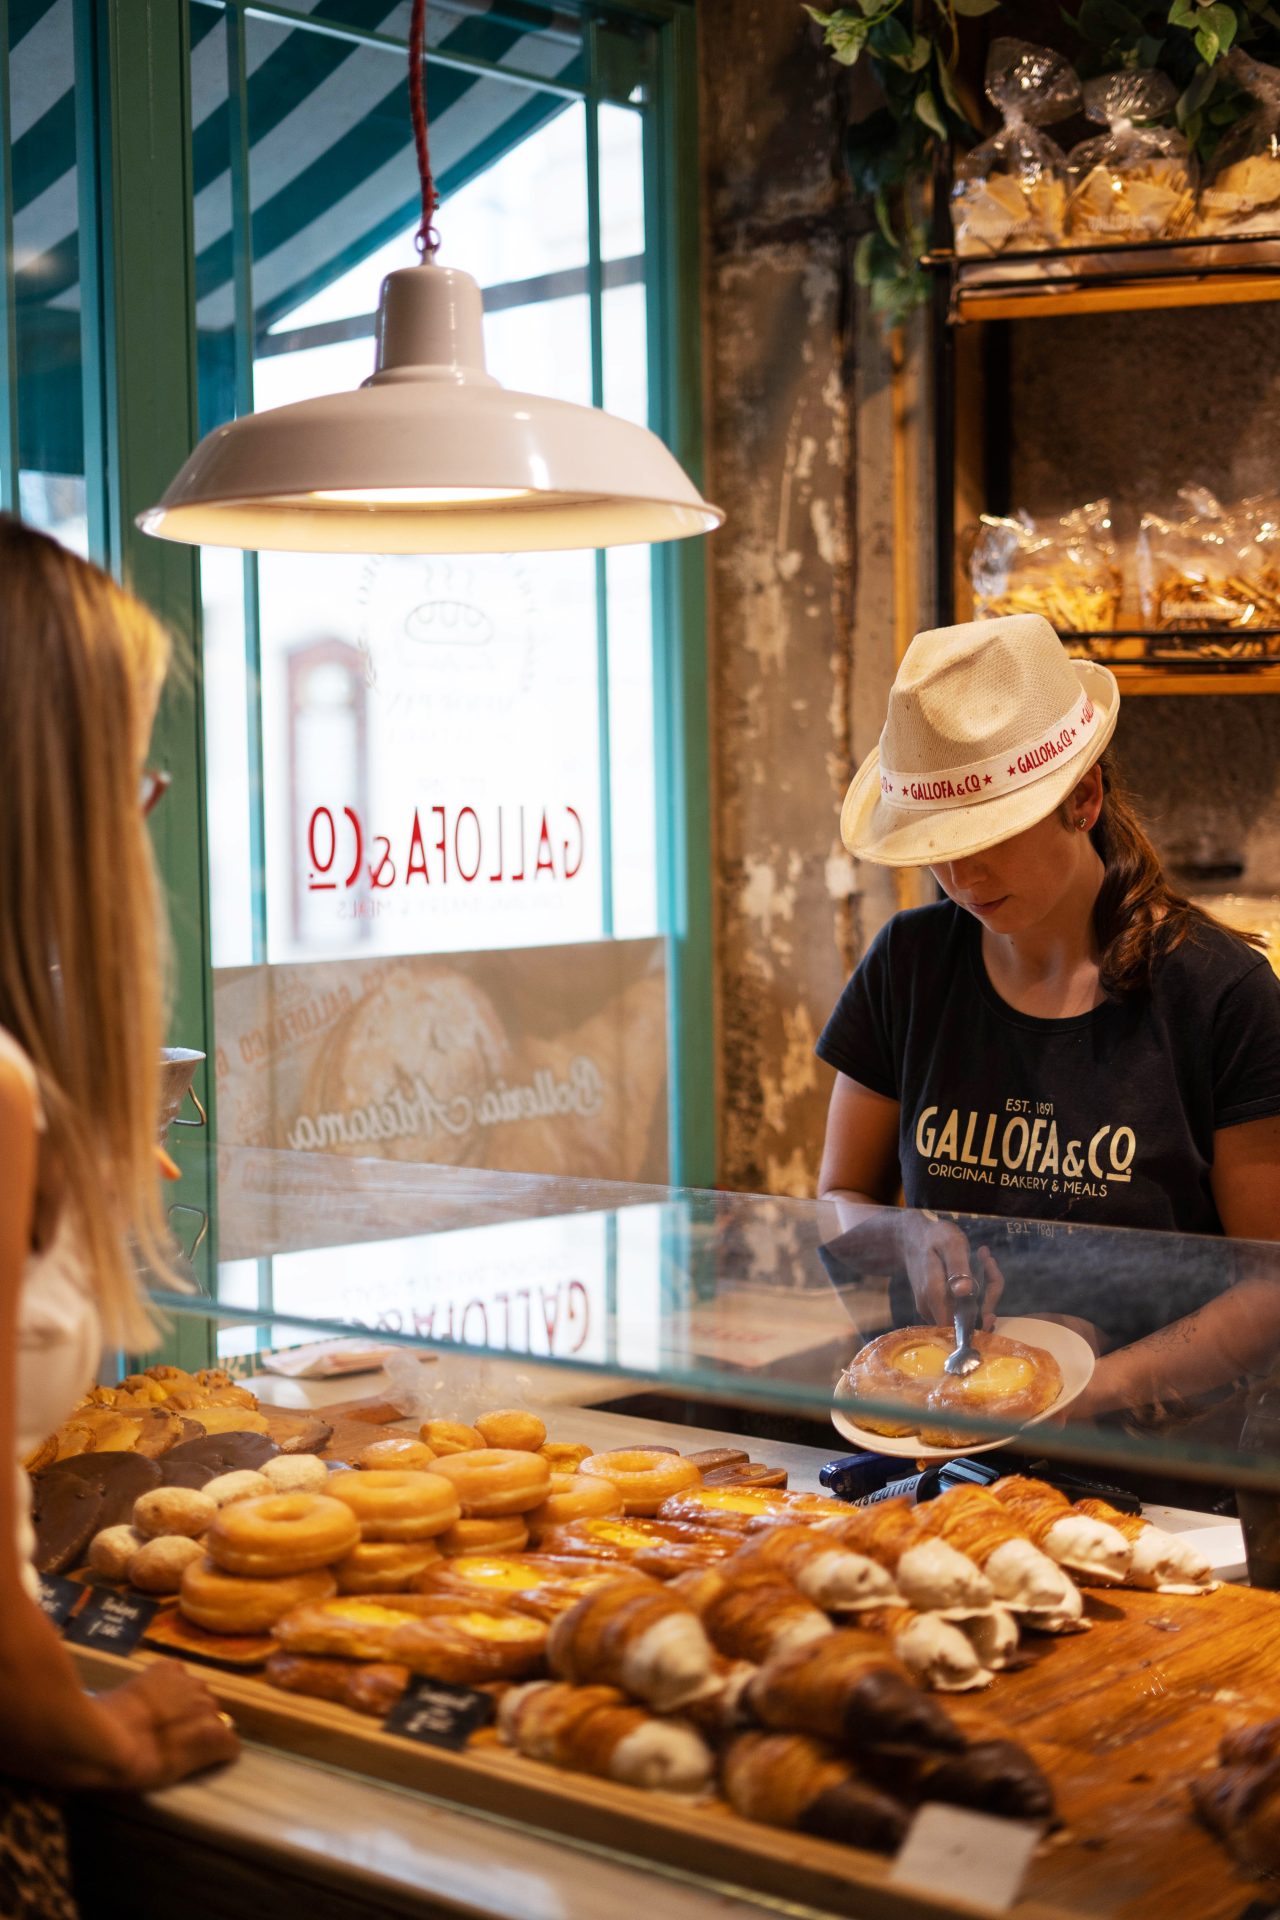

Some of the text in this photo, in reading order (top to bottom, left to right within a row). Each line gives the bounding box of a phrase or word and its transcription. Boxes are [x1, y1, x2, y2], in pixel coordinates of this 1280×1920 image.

[910, 774, 982, 801] GALLOFA&CO
[1005, 1098, 1054, 1116] EST. 1891
[927, 1163, 996, 1186] ORIGINAL
[1000, 1173, 1049, 1192] BAKERY
[1063, 1181, 1108, 1198] MEALS
